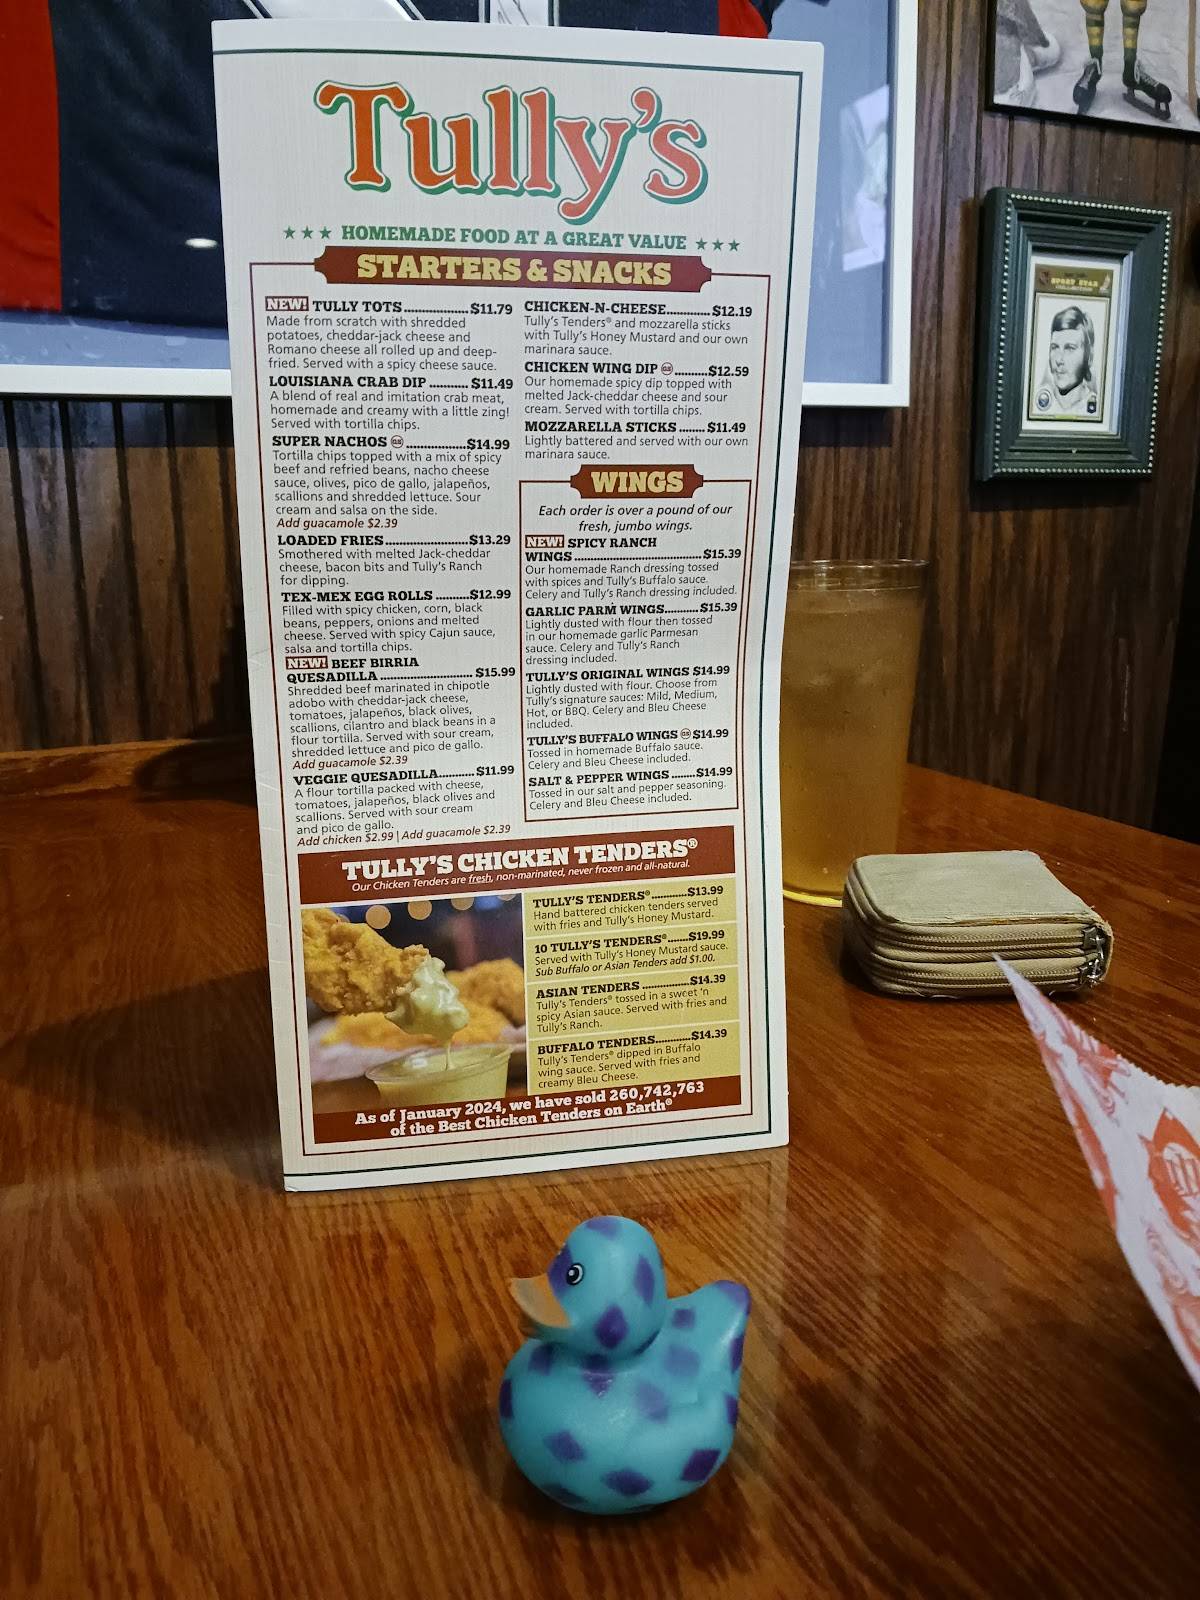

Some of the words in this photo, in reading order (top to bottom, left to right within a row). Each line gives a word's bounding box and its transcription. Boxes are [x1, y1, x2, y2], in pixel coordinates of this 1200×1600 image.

[314, 80, 708, 225] Tully's
[342, 226, 455, 242] HOMEMADE
[460, 228, 509, 243] FOOD
[514, 230, 539, 244] AT
[544, 231, 558, 245] A
[563, 232, 624, 247] GREAT
[628, 234, 686, 249] VALUE
[357, 255, 521, 281] STARTERS
[526, 260, 548, 282] &
[553, 259, 671, 286] SNACKS
[266, 298, 307, 310] NEW!
[313, 301, 358, 312] TULLY
[362, 302, 402, 312] TOTS
[471, 303, 512, 314] $11.79
[525, 301, 666, 314] CHICKEN-N-CHEESE
[712, 305, 752, 317] $12.19
[267, 315, 300, 326] Made
[304, 315, 332, 326] from
[336, 316, 376, 326] scratch
[381, 316, 407, 327] with
[411, 317, 465, 328] shredded
[525, 362, 588, 373] CHICKEN
[592, 363, 631, 373] WING
[636, 364, 658, 374] DIP
[708, 365, 749, 377] $12.59
[270, 376, 353, 386] LOUISIANA
[357, 377, 398, 387] CRAB
[402, 377, 426, 388] DIP
[471, 378, 513, 389] $11.49
[525, 421, 622, 432] MOZZARELLA
[626, 422, 676, 432] STICKS
[708, 422, 746, 433] $11.49
[272, 436, 320, 446] SUPER
[324, 436, 387, 447] NACHOS
[467, 438, 510, 450] $14.99
[526, 435, 562, 448] Lightly
[566, 435, 612, 446] battered
[616, 436, 636, 446] and
[640, 436, 674, 446] served
[678, 436, 701, 446] with
[705, 438, 723, 446] our
[726, 438, 748, 446] own
[274, 480, 309, 489] sauce,
[314, 477, 348, 489] olives,
[354, 480, 377, 490] pico
[381, 478, 394, 488] de
[399, 478, 429, 491] gallo,
[433, 478, 490, 491] jalapeños,
[591, 471, 684, 493] WINGS
[539, 505, 566, 516] Each
[570, 505, 602, 516] order
[606, 505, 614, 515] is
[656, 504, 695, 517] pound
[698, 504, 710, 514] of
[277, 518, 300, 527] Add
[304, 518, 364, 530] guacamole
[368, 518, 397, 528] $2.39
[579, 521, 610, 532] fresh,
[614, 520, 651, 534] jumbo
[656, 522, 692, 533] wings.
[278, 535, 336, 545] LOADED
[341, 536, 383, 545] FRIES
[470, 534, 510, 545] $13.29
[526, 536, 563, 547] NEW!
[568, 538, 606, 548] SPICY
[610, 538, 656, 547] RANCH
[279, 549, 342, 559] Smothered
[346, 549, 372, 558] with
[376, 548, 415, 558] melted
[419, 548, 490, 558] Jack-cheddar
[525, 552, 572, 562] WINGS
[703, 549, 741, 559] $15.39
[281, 592, 351, 602] TEX-MEX
[355, 592, 384, 601] EGG
[388, 591, 432, 600] ROLLS
[470, 589, 511, 600] $12.99
[526, 607, 574, 616] GARLIC
[578, 606, 616, 615] PARM
[620, 605, 664, 614] WINGS
[700, 602, 737, 612] $15.39
[287, 657, 326, 669] NEW!
[332, 659, 366, 668] BEEF
[370, 658, 419, 668] BIRRIA
[287, 672, 378, 684] QUESADILLA
[476, 667, 515, 678] $15.99
[526, 672, 577, 682] TULLY'S
[581, 669, 643, 680] ORIGINAL
[646, 667, 689, 677] WINGS
[693, 666, 730, 676] $14.99
[527, 735, 576, 746] TULLY'S
[579, 732, 634, 743] BUFFALO
[636, 730, 678, 740] WINGS
[693, 729, 728, 739] $14.99
[293, 774, 347, 785] VEGGIE
[351, 770, 440, 783] QUESADILLA
[476, 766, 514, 776] $11.99
[529, 776, 562, 786] SALT
[565, 776, 573, 784] &
[577, 773, 623, 784] PEPPER
[626, 770, 669, 781] WINGS
[696, 767, 732, 777] $14.99
[530, 800, 561, 811] Celery
[564, 798, 582, 808] and
[586, 797, 607, 806] Bleu
[611, 796, 644, 805] Cheese
[648, 792, 691, 803] included.
[342, 856, 453, 880] TULLY'S
[458, 848, 569, 873] CHICKEN
[533, 896, 583, 908] TULLY'S
[688, 886, 723, 897] $13.99
[534, 909, 560, 920] Hand
[564, 906, 606, 917] battered
[610, 904, 645, 914] chicken
[648, 901, 684, 911] tenders
[687, 897, 718, 908] served
[535, 944, 547, 953] 10
[550, 940, 600, 952] TULLY'S
[689, 930, 724, 941] $19.99
[536, 987, 578, 999] ASIAN
[581, 982, 639, 994] TENDERS
[690, 974, 725, 985] $14.39
[538, 1041, 594, 1054] BUFFALO
[597, 1036, 655, 1049] TENDERS
[692, 1029, 727, 1040] $14.39
[539, 1079, 574, 1088] creamy
[577, 1076, 598, 1084] Bleu
[602, 1073, 638, 1082] Cheese.
[355, 1113, 376, 1125] As
[380, 1109, 395, 1122] of
[400, 1107, 462, 1123] January
[465, 1101, 507, 1114] 2024,
[509, 1101, 531, 1110] we
[535, 1095, 572, 1108] have
[575, 1090, 606, 1104] sold
[610, 1082, 704, 1101] 260,742,763
[391, 1123, 406, 1137] of
[410, 1122, 434, 1134] the
[439, 1120, 471, 1132] Best
[475, 1113, 537, 1128] Chicken
[541, 1108, 601, 1123] Tenders
[604, 1107, 622, 1116] on
